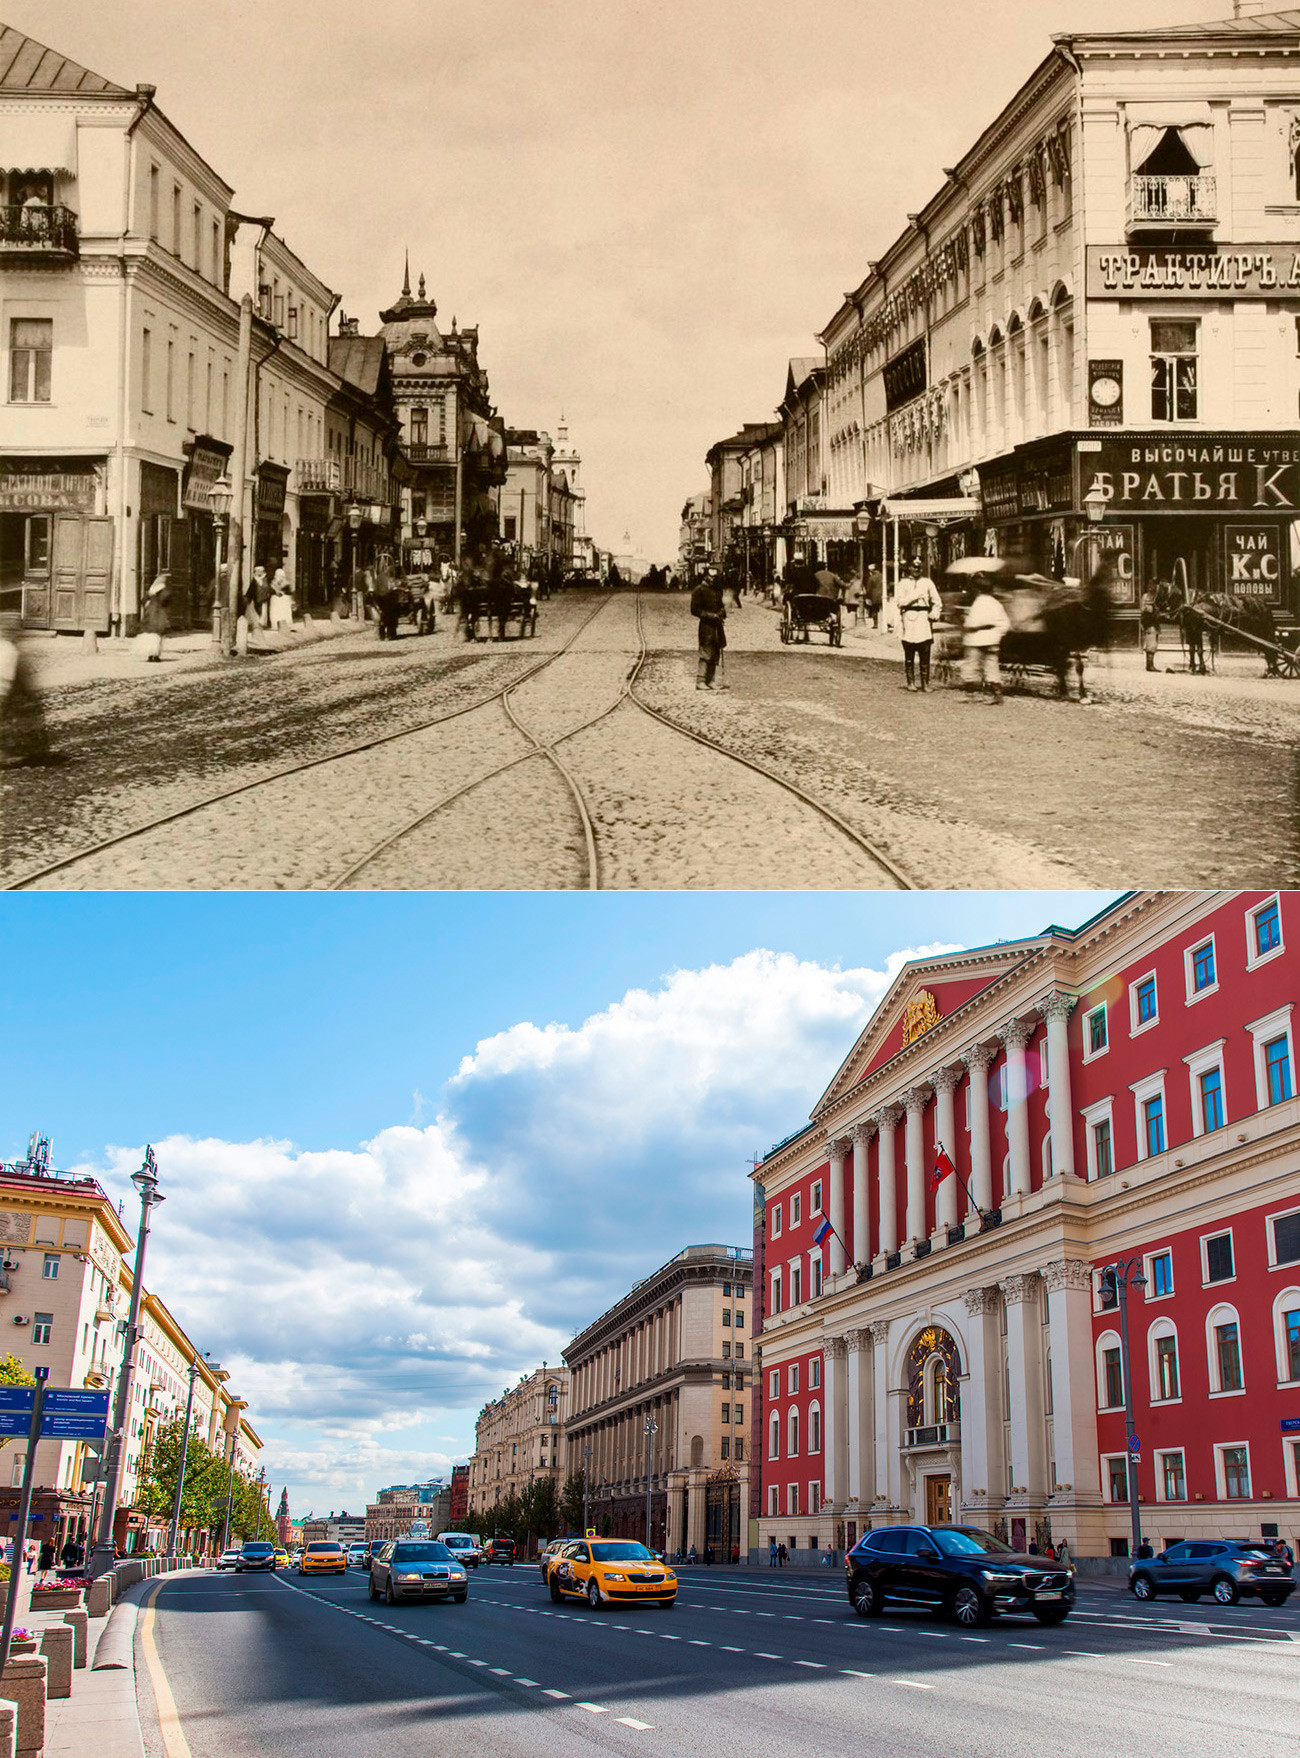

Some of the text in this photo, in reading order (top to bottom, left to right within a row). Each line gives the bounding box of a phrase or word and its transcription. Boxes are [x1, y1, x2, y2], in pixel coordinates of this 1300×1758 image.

[1131, 445, 1256, 463] ВЫСОЧАЙШЕ
[1095, 472, 1238, 500] БРАТЬЯ
[1252, 464, 1295, 507] К
[1236, 532, 1268, 550] ЧАЙ
